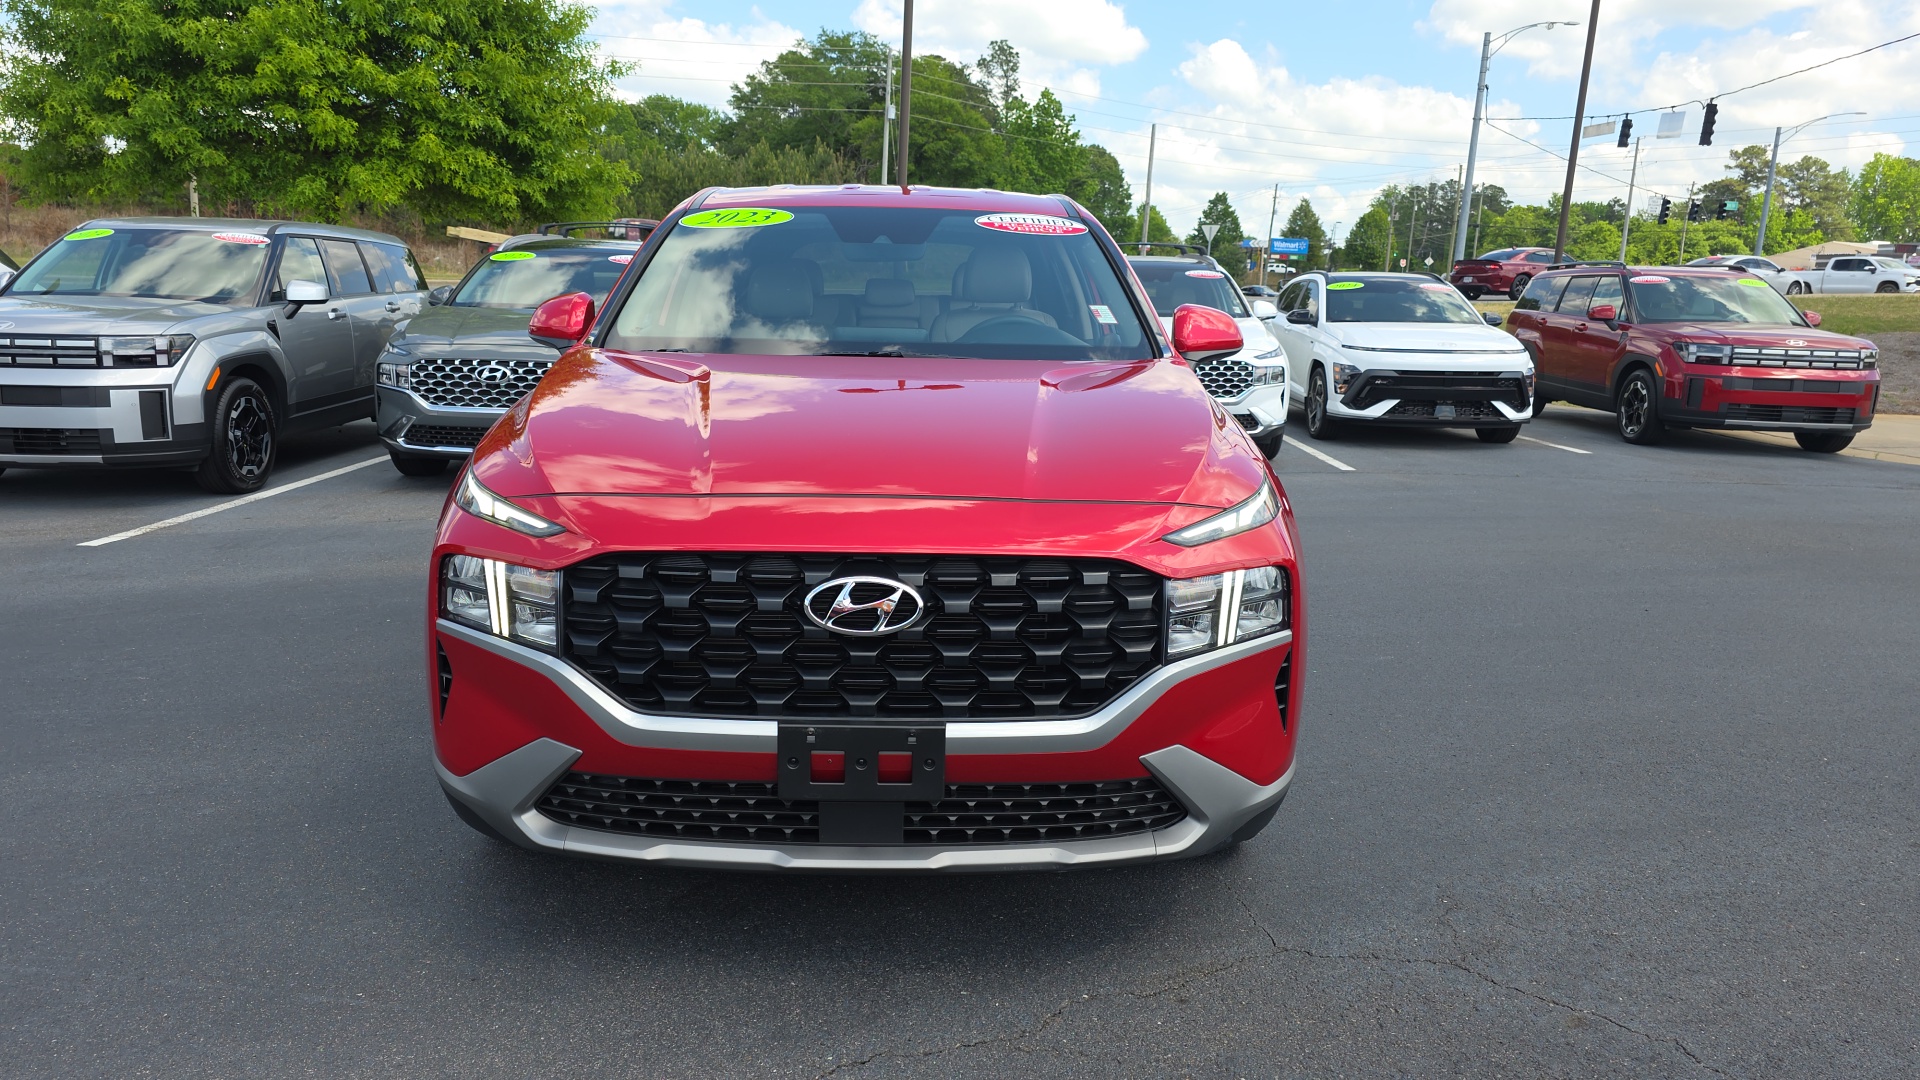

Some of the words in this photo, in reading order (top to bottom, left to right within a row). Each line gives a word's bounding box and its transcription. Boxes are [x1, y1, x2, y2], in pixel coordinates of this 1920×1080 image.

[695, 211, 777, 225] 2023
[987, 215, 1075, 227] CERTIFIED
[993, 222, 1073, 231] PRE-OWNED
[1008, 226, 1064, 234] VEHICLE
[1273, 241, 1299, 249] Walmart
